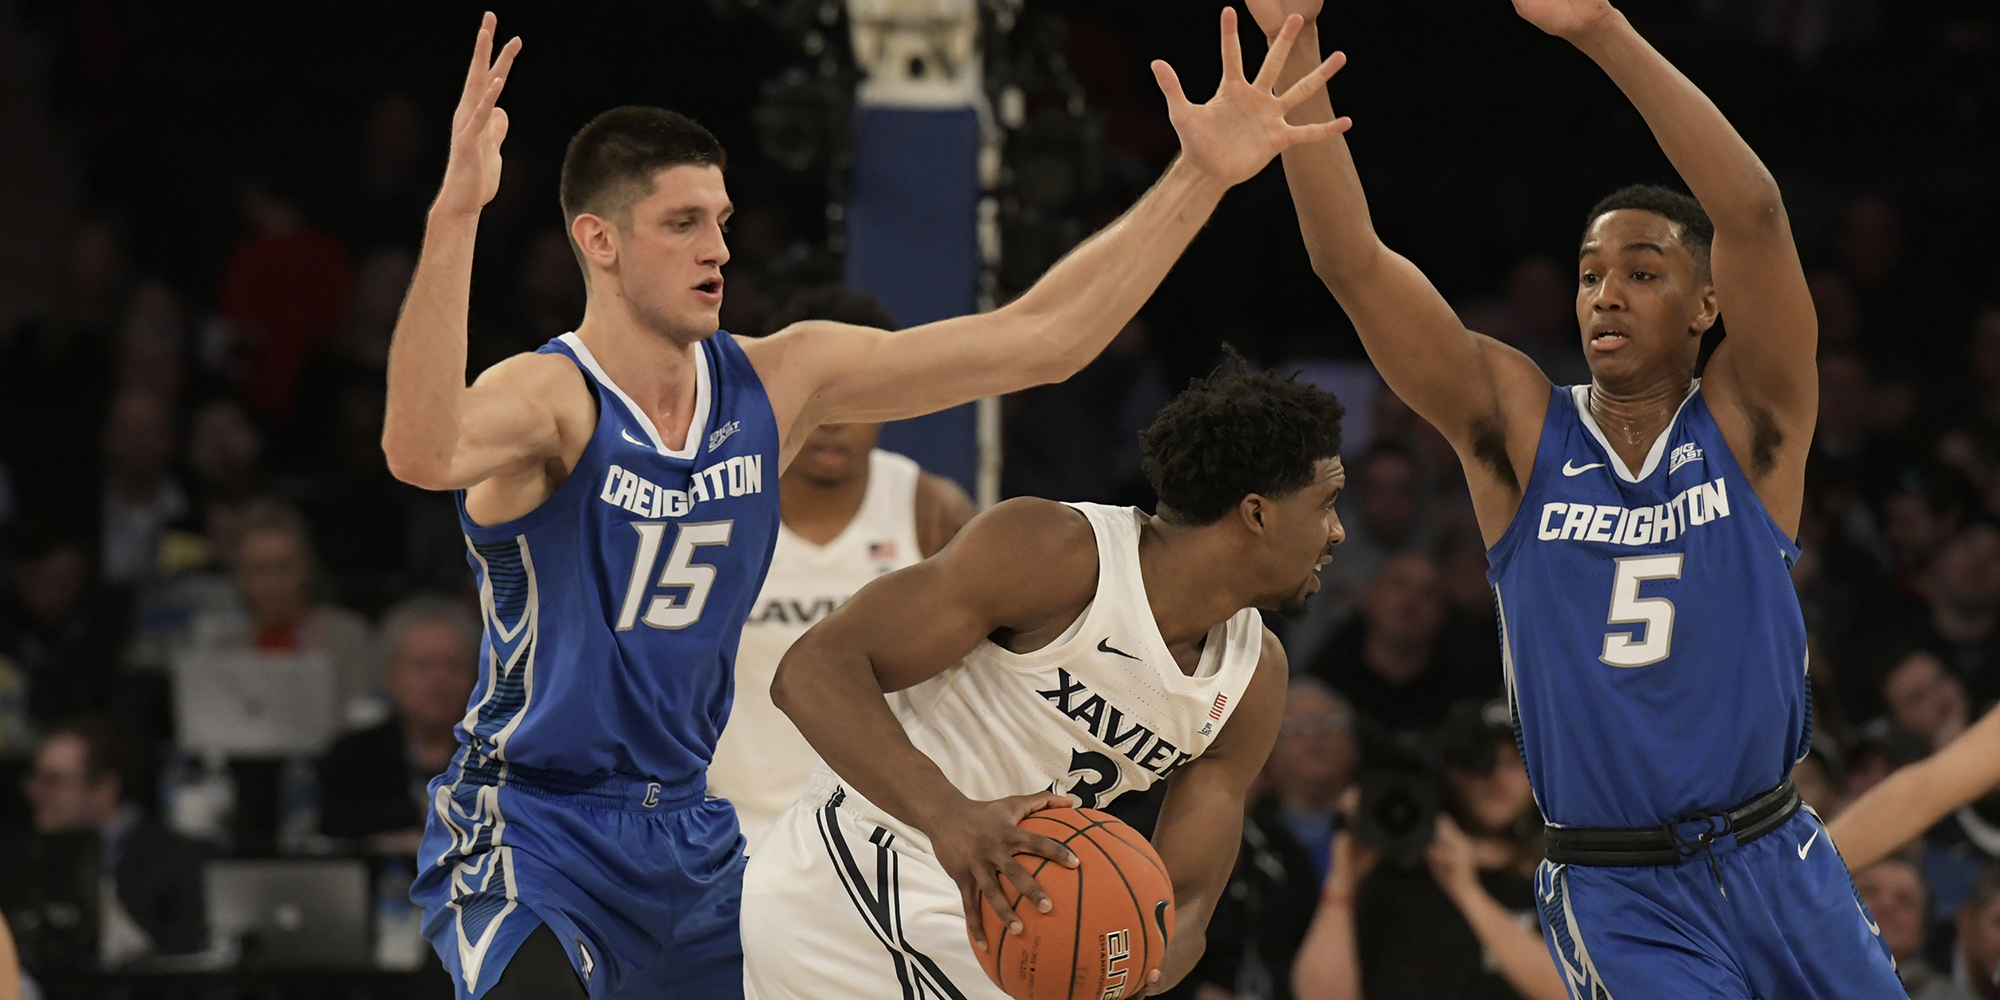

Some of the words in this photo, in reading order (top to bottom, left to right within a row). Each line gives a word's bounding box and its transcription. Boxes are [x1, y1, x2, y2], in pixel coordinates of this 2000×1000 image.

[1669, 448, 1703, 470] EAST
[1670, 442, 1695, 460] BIG
[600, 454, 762, 519] CREIGHTON
[1537, 477, 1731, 546] CREIGHTON
[615, 519, 734, 632] 15
[747, 598, 851, 624] AVI
[1597, 552, 1685, 668] 5
[641, 782, 661, 808] C
[1095, 934, 1106, 1000] CHAMPIONS
[1101, 928, 1130, 1000] ELITE
